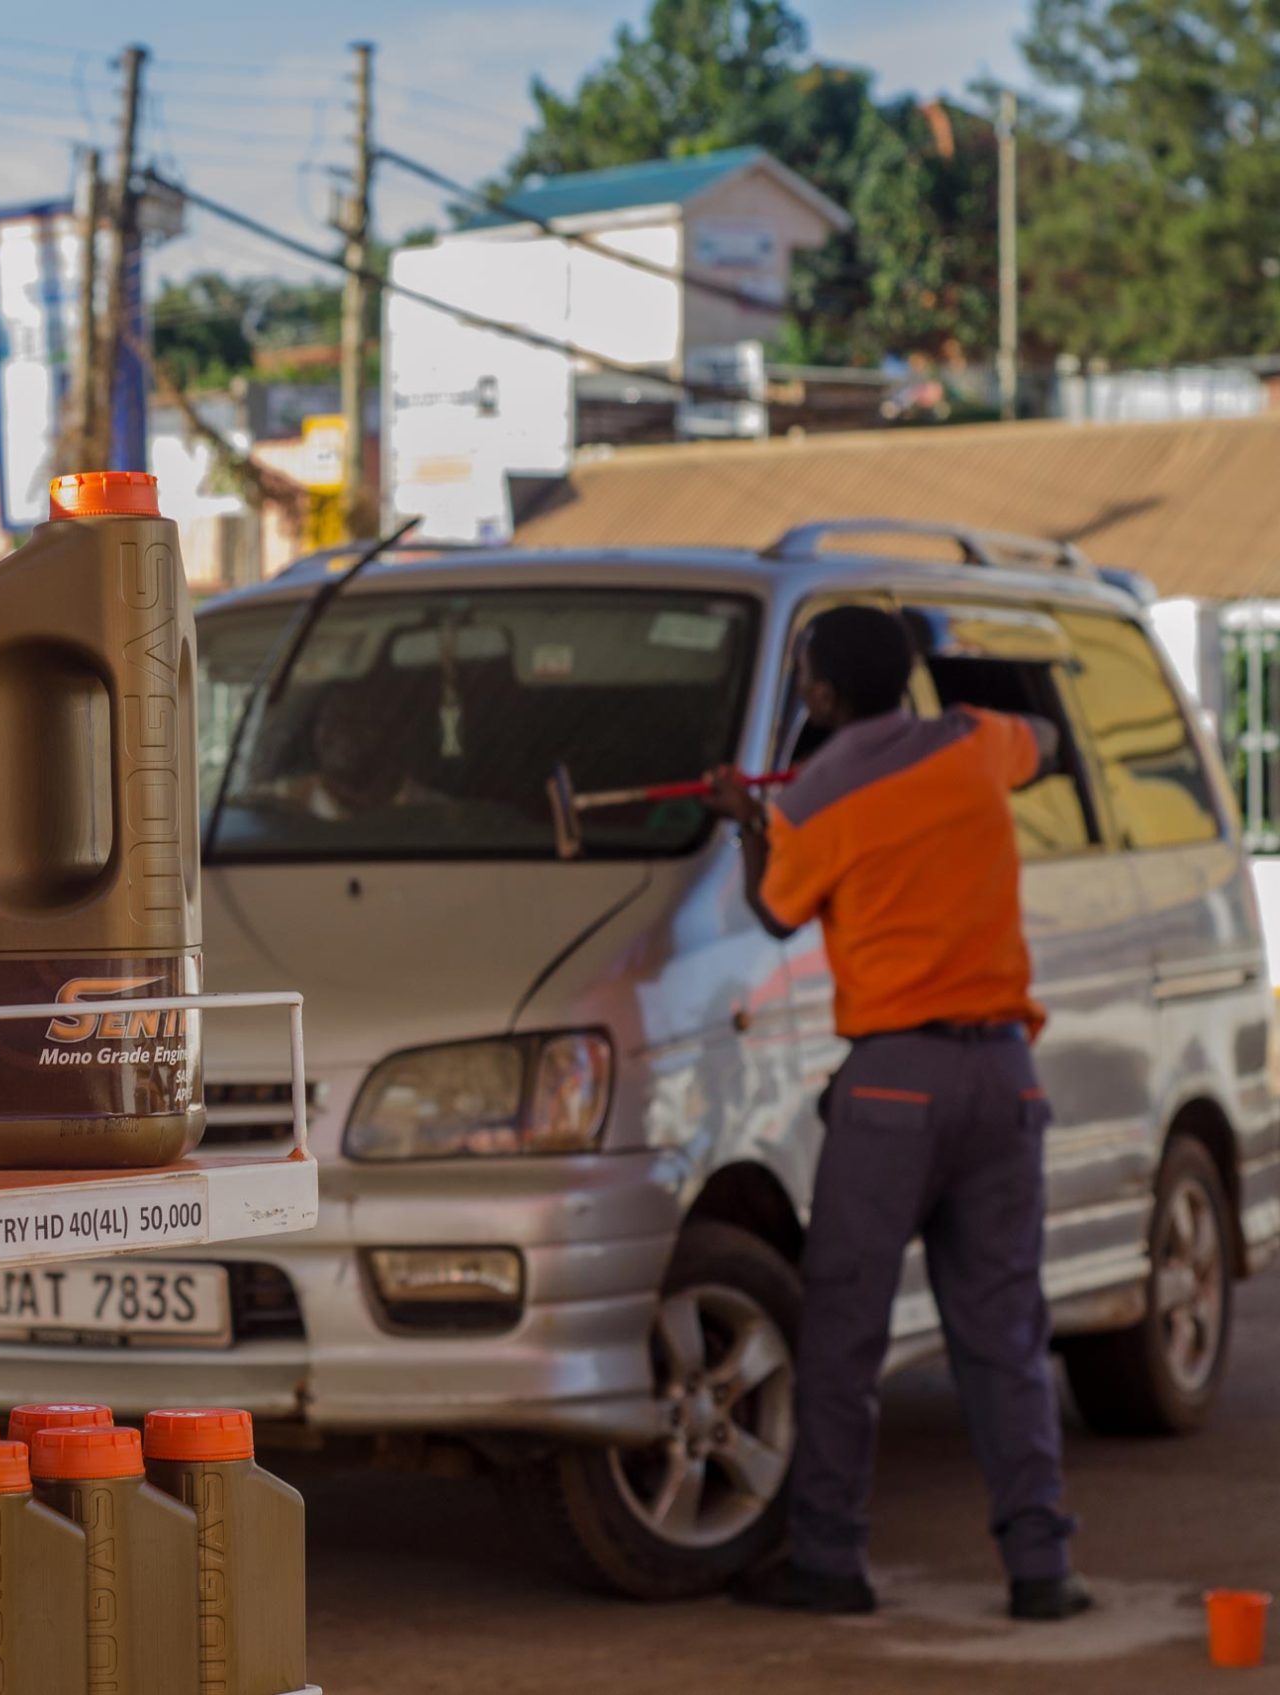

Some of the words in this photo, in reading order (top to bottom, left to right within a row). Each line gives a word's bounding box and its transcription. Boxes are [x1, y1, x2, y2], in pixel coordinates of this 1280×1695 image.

[39, 1048, 91, 1065] Mono
[96, 1046, 150, 1064] Grade
[35, 1214, 64, 1241] HD
[69, 1206, 129, 1242] 40(4L)
[140, 1202, 202, 1234] 50,000
[92, 1273, 197, 1323] 783S
